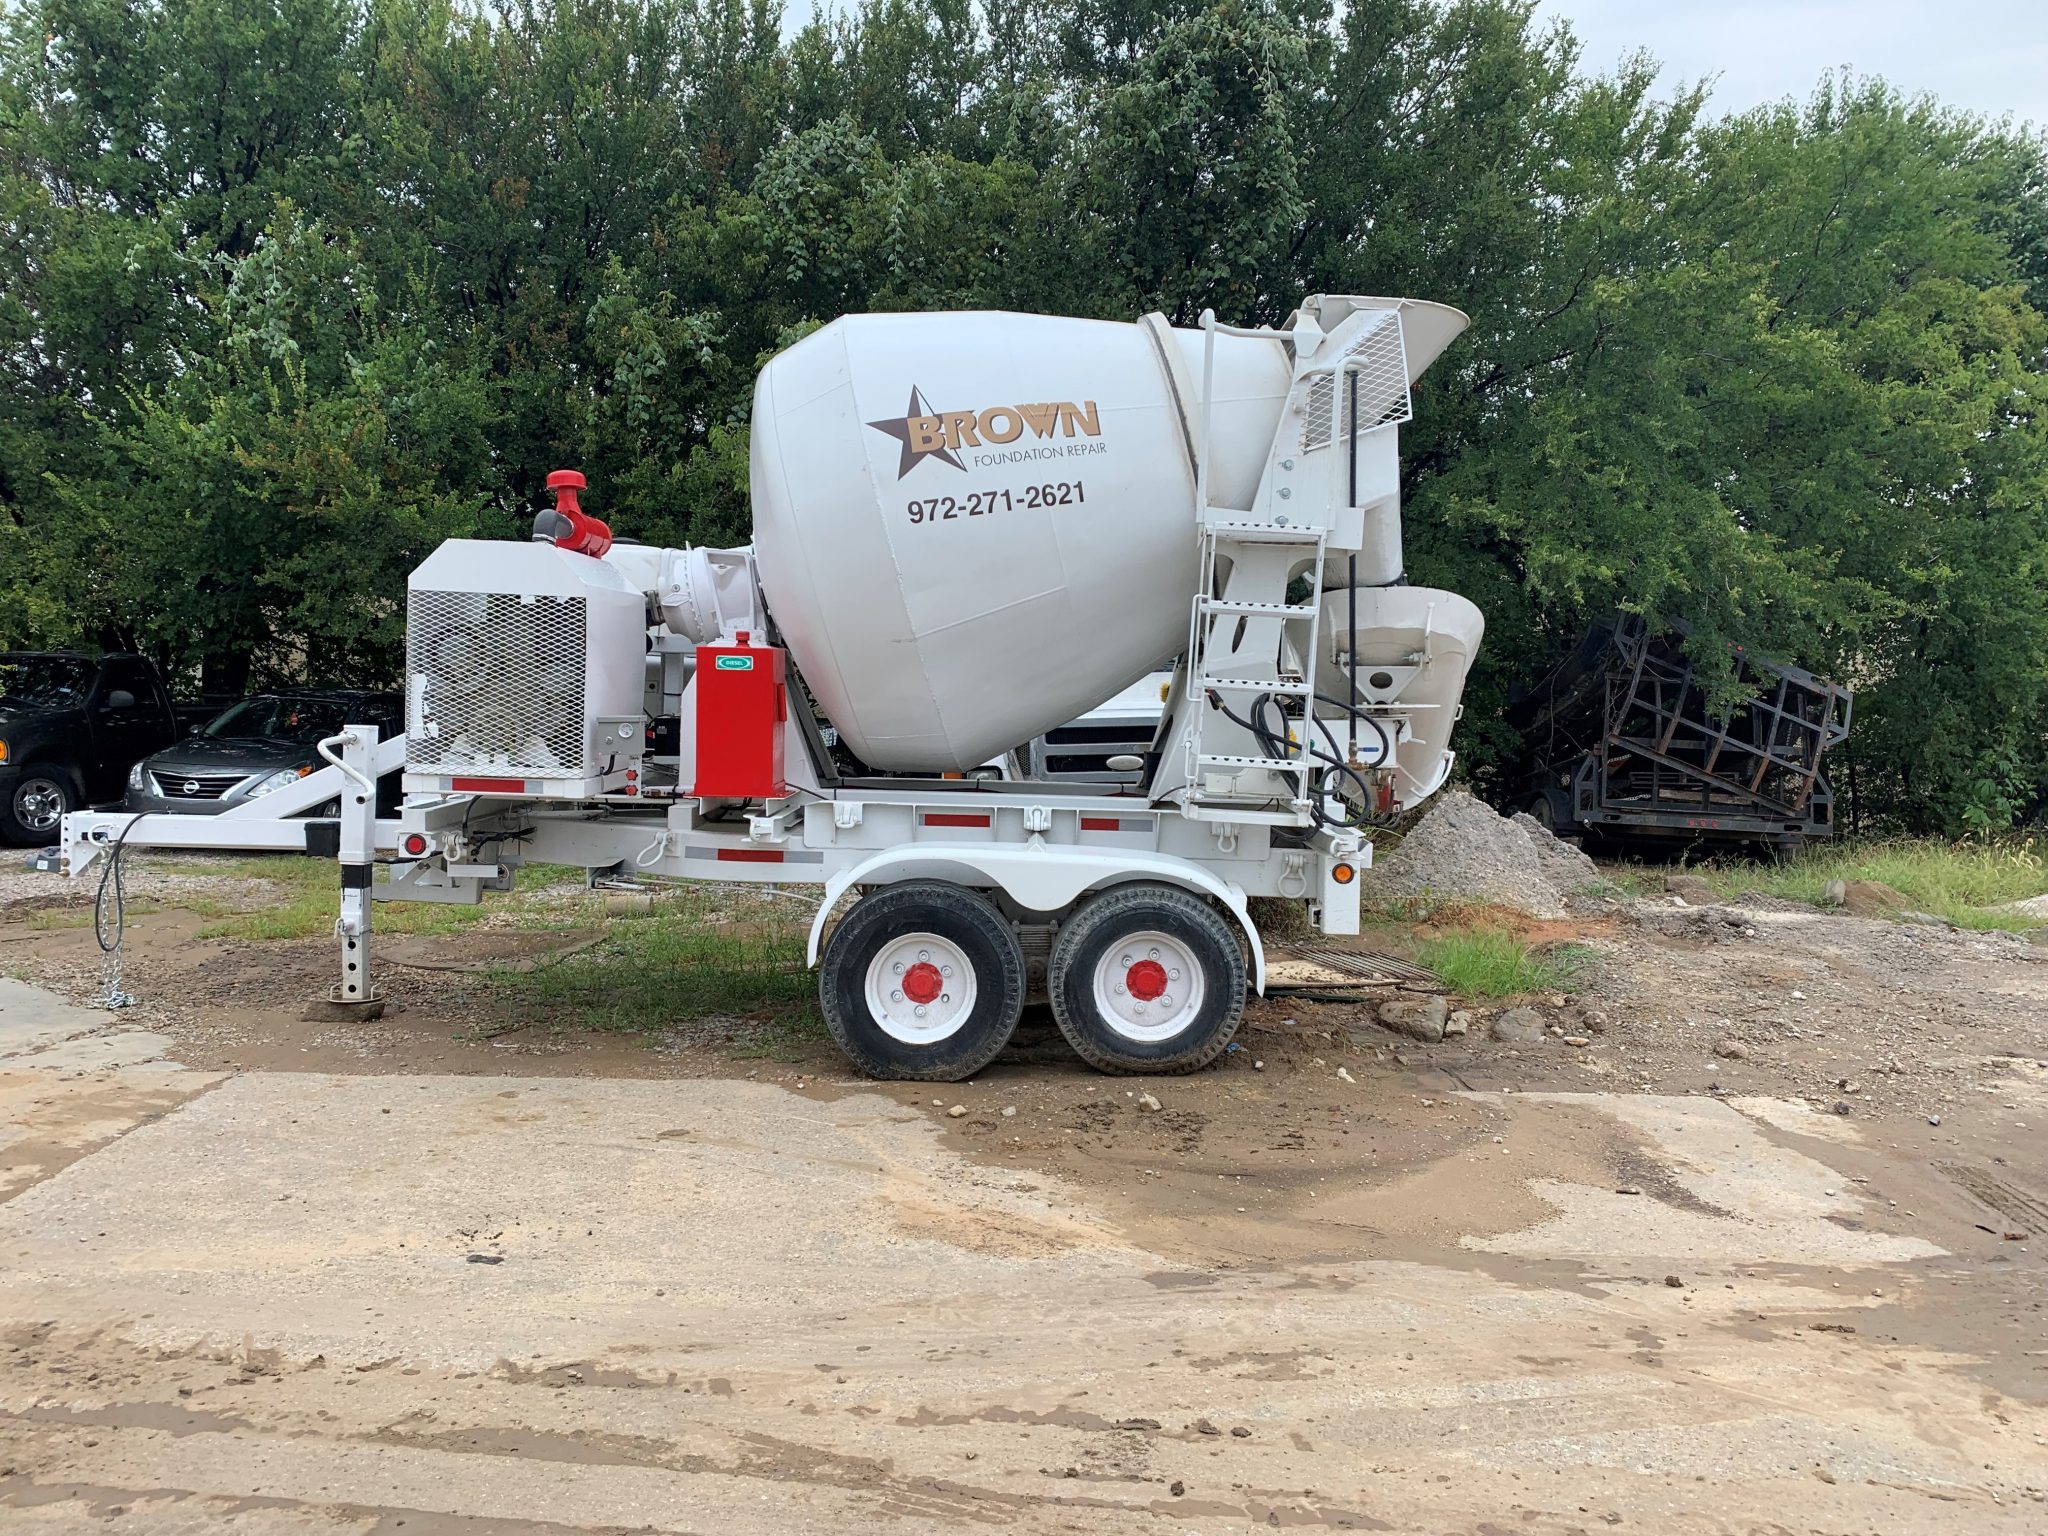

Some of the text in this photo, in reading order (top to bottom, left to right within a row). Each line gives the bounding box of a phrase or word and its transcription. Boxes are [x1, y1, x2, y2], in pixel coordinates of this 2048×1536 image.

[907, 400, 1101, 453] BROWN
[974, 442, 1108, 467] FOUNDATION REPAIR
[907, 480, 1085, 524] 972-271-2621
